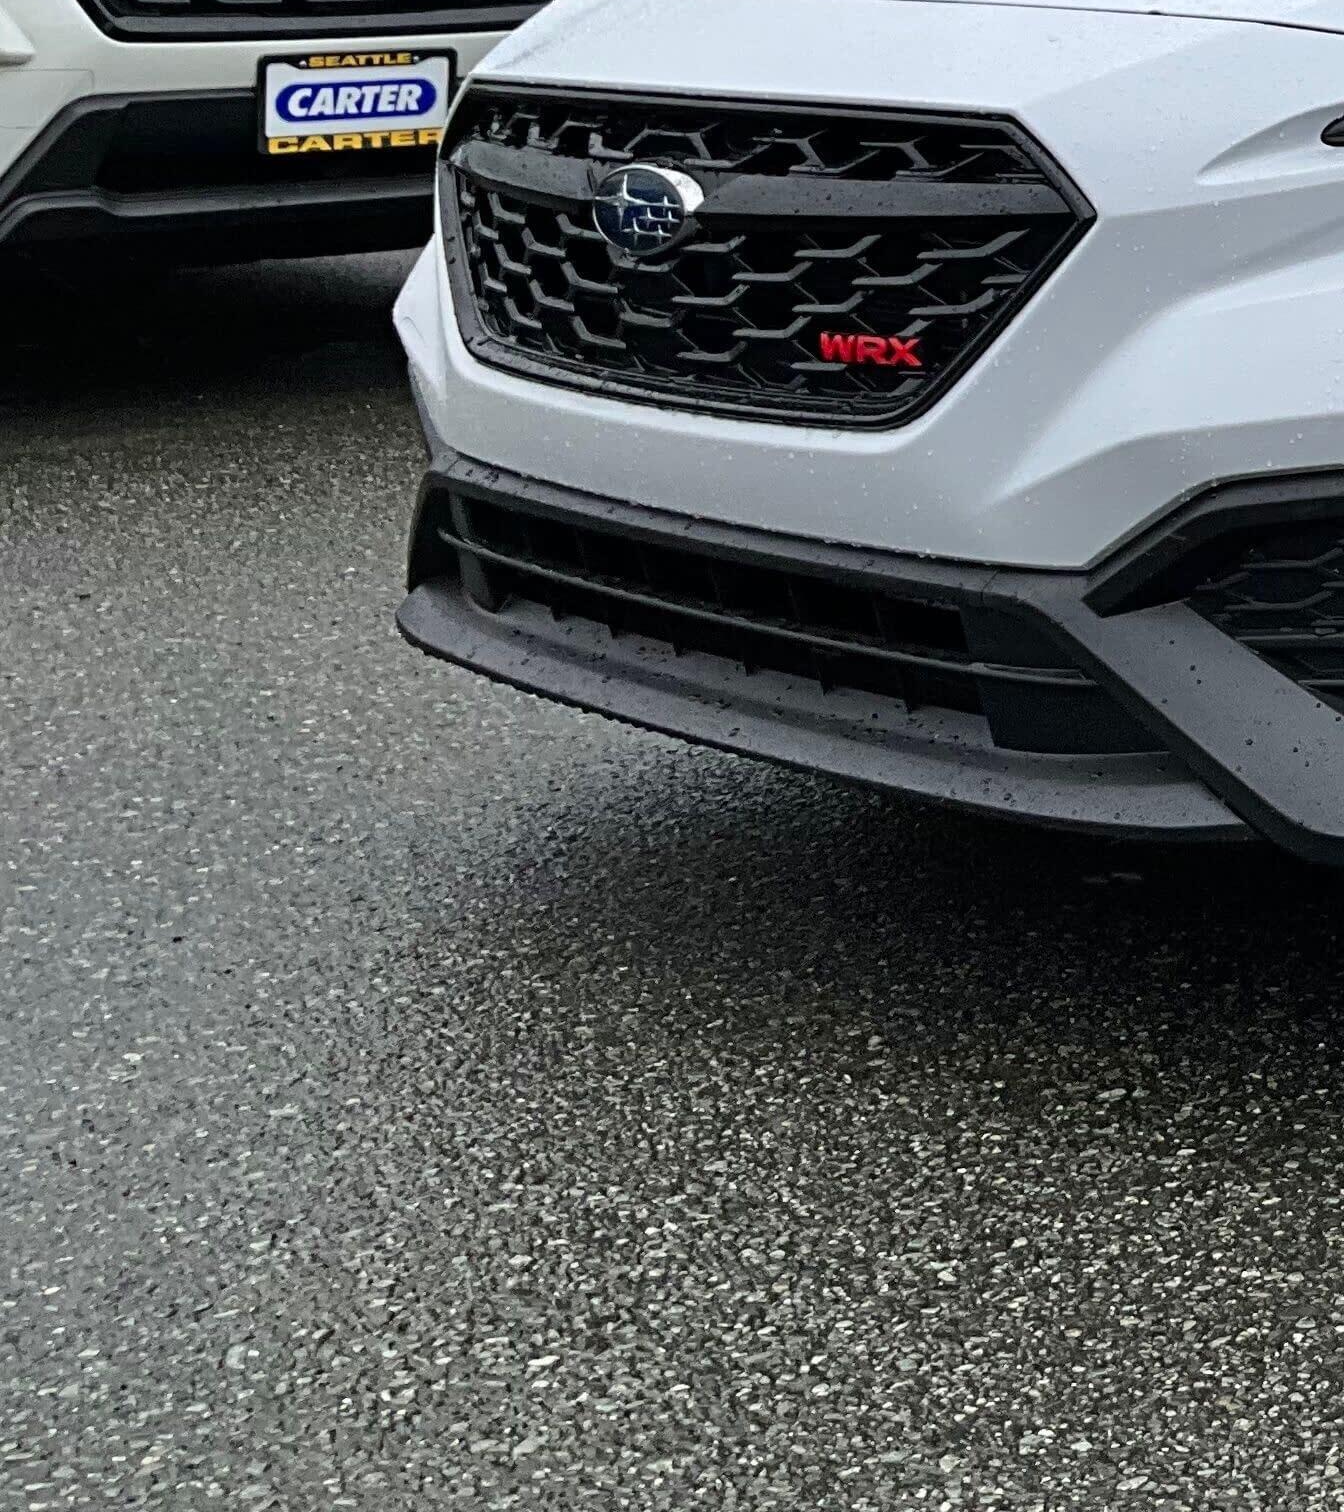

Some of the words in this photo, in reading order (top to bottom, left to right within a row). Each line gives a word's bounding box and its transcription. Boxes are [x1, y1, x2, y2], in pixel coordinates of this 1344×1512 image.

[308, 52, 412, 68] SEATTLE
[287, 83, 423, 118] CARTER
[268, 127, 443, 155] CARTER
[819, 332, 922, 366] WRX
